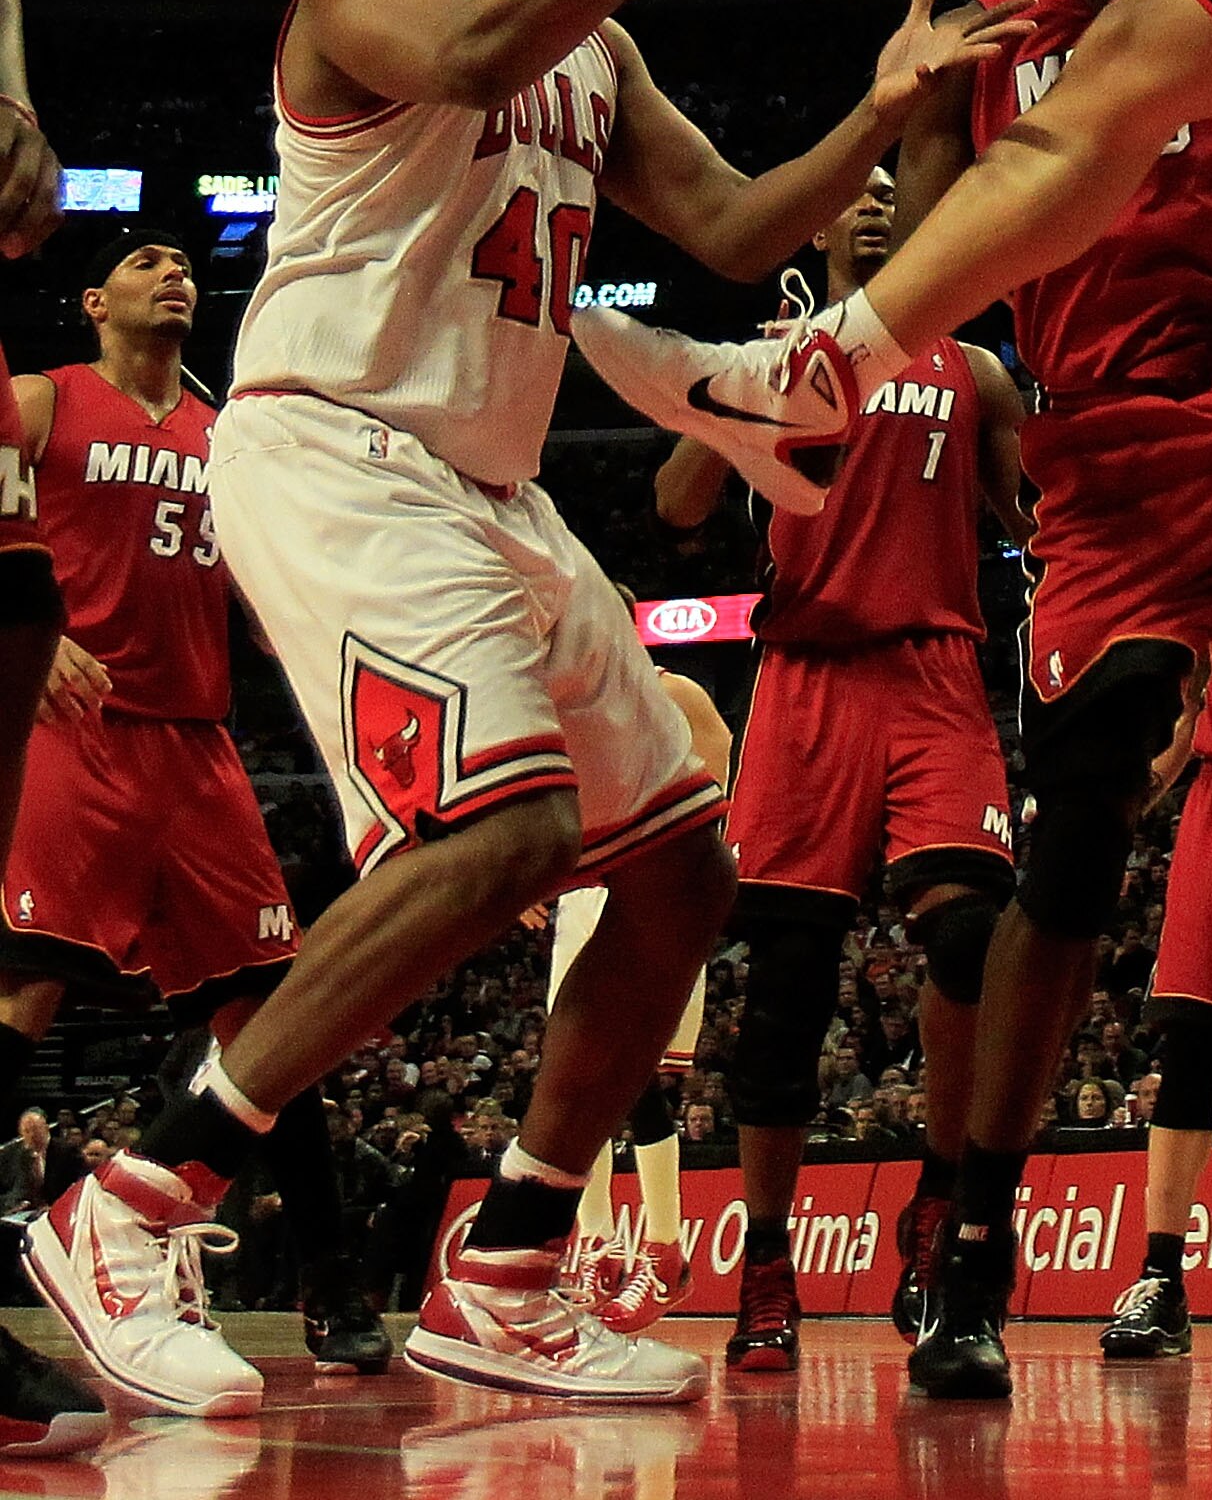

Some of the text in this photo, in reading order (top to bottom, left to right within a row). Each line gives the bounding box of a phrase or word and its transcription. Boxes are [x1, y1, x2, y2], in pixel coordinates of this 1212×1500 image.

[859, 380, 956, 422] AMI
[84, 441, 211, 495] MIAM
[922, 430, 947, 481] 1
[659, 606, 707, 632] KIA
[711, 1195, 880, 1275] Oima
[1013, 1183, 1127, 1272] icial
